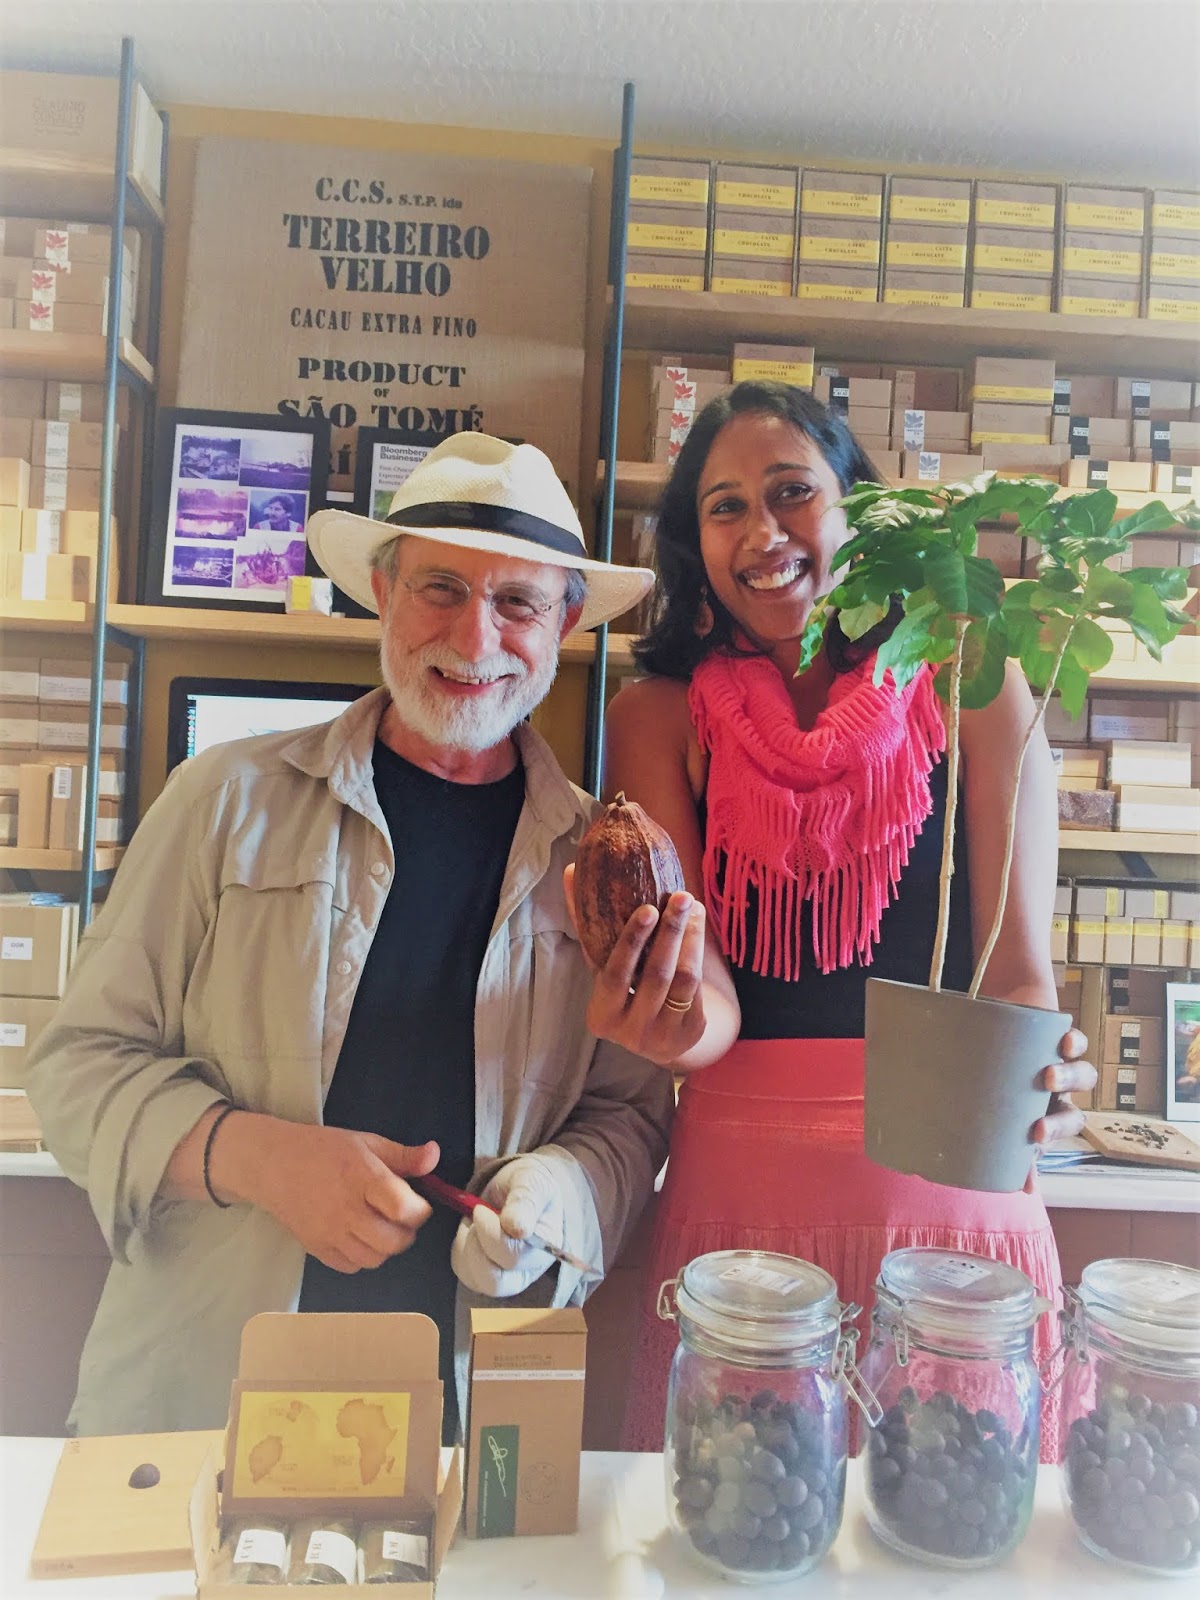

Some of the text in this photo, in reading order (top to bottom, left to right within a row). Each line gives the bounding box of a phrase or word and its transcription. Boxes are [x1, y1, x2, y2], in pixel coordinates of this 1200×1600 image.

[315, 177, 393, 204] C.C.S.
[283, 213, 490, 260] TERREIRO
[320, 256, 451, 297] VELHO
[290, 307, 477, 338] CACAU EXTRA FINO
[298, 357, 466, 388] PRODUCT
[374, 388, 390, 398] OF
[371, 404, 484, 434] TOMÉ
[380, 446, 428, 457] Bloomberg
